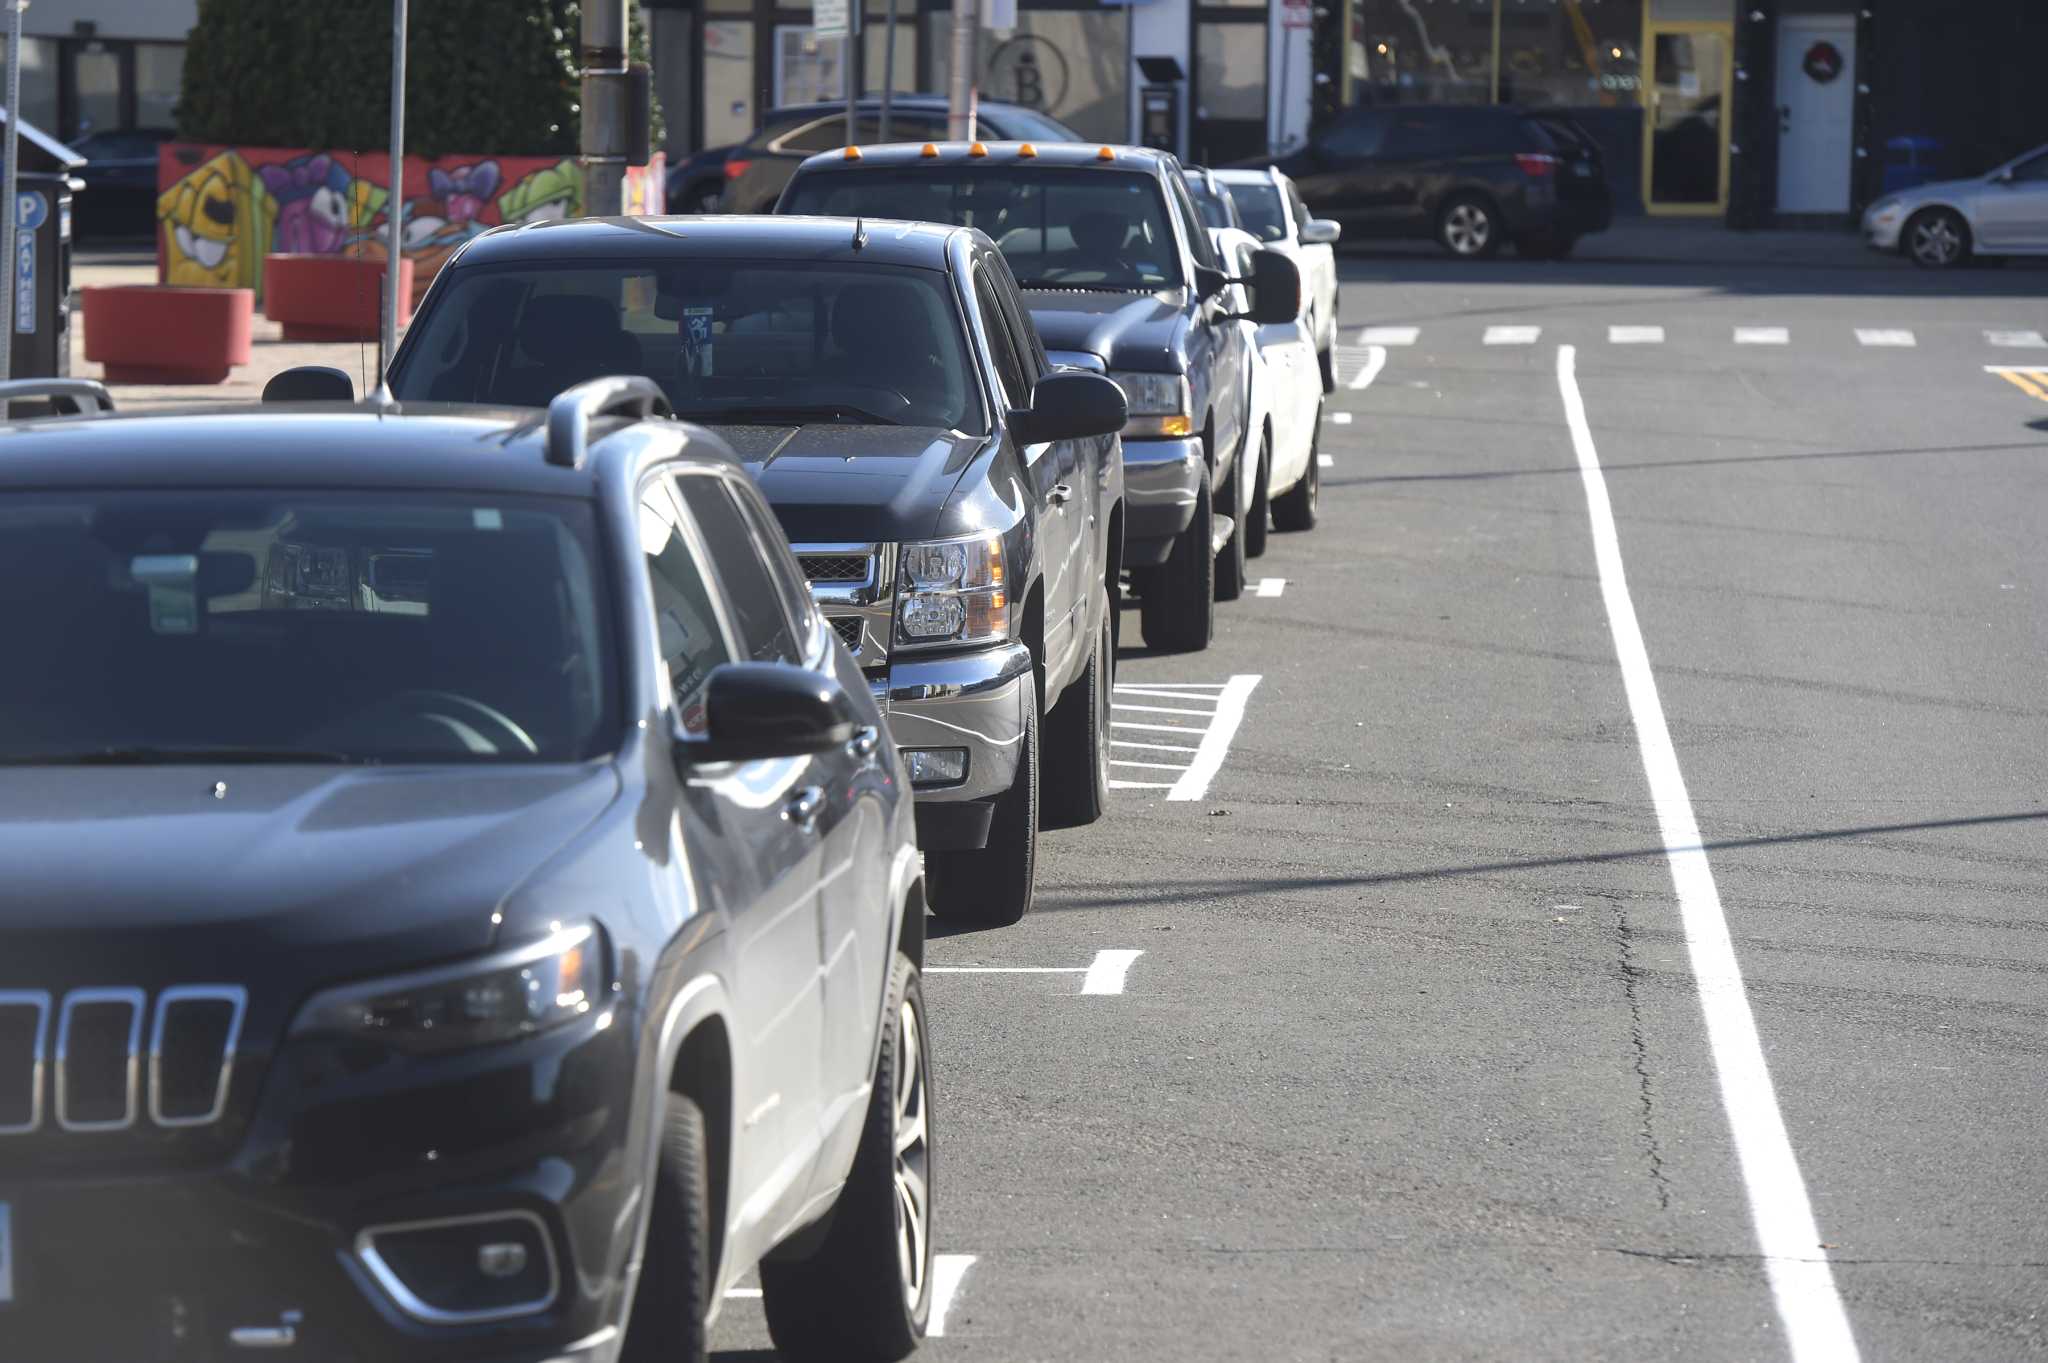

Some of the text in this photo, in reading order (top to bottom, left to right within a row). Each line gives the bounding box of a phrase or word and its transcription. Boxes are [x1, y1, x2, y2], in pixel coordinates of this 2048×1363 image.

[1014, 66, 1043, 105] B
[19, 195, 36, 225] P
[19, 234, 32, 329] PAY HERE
